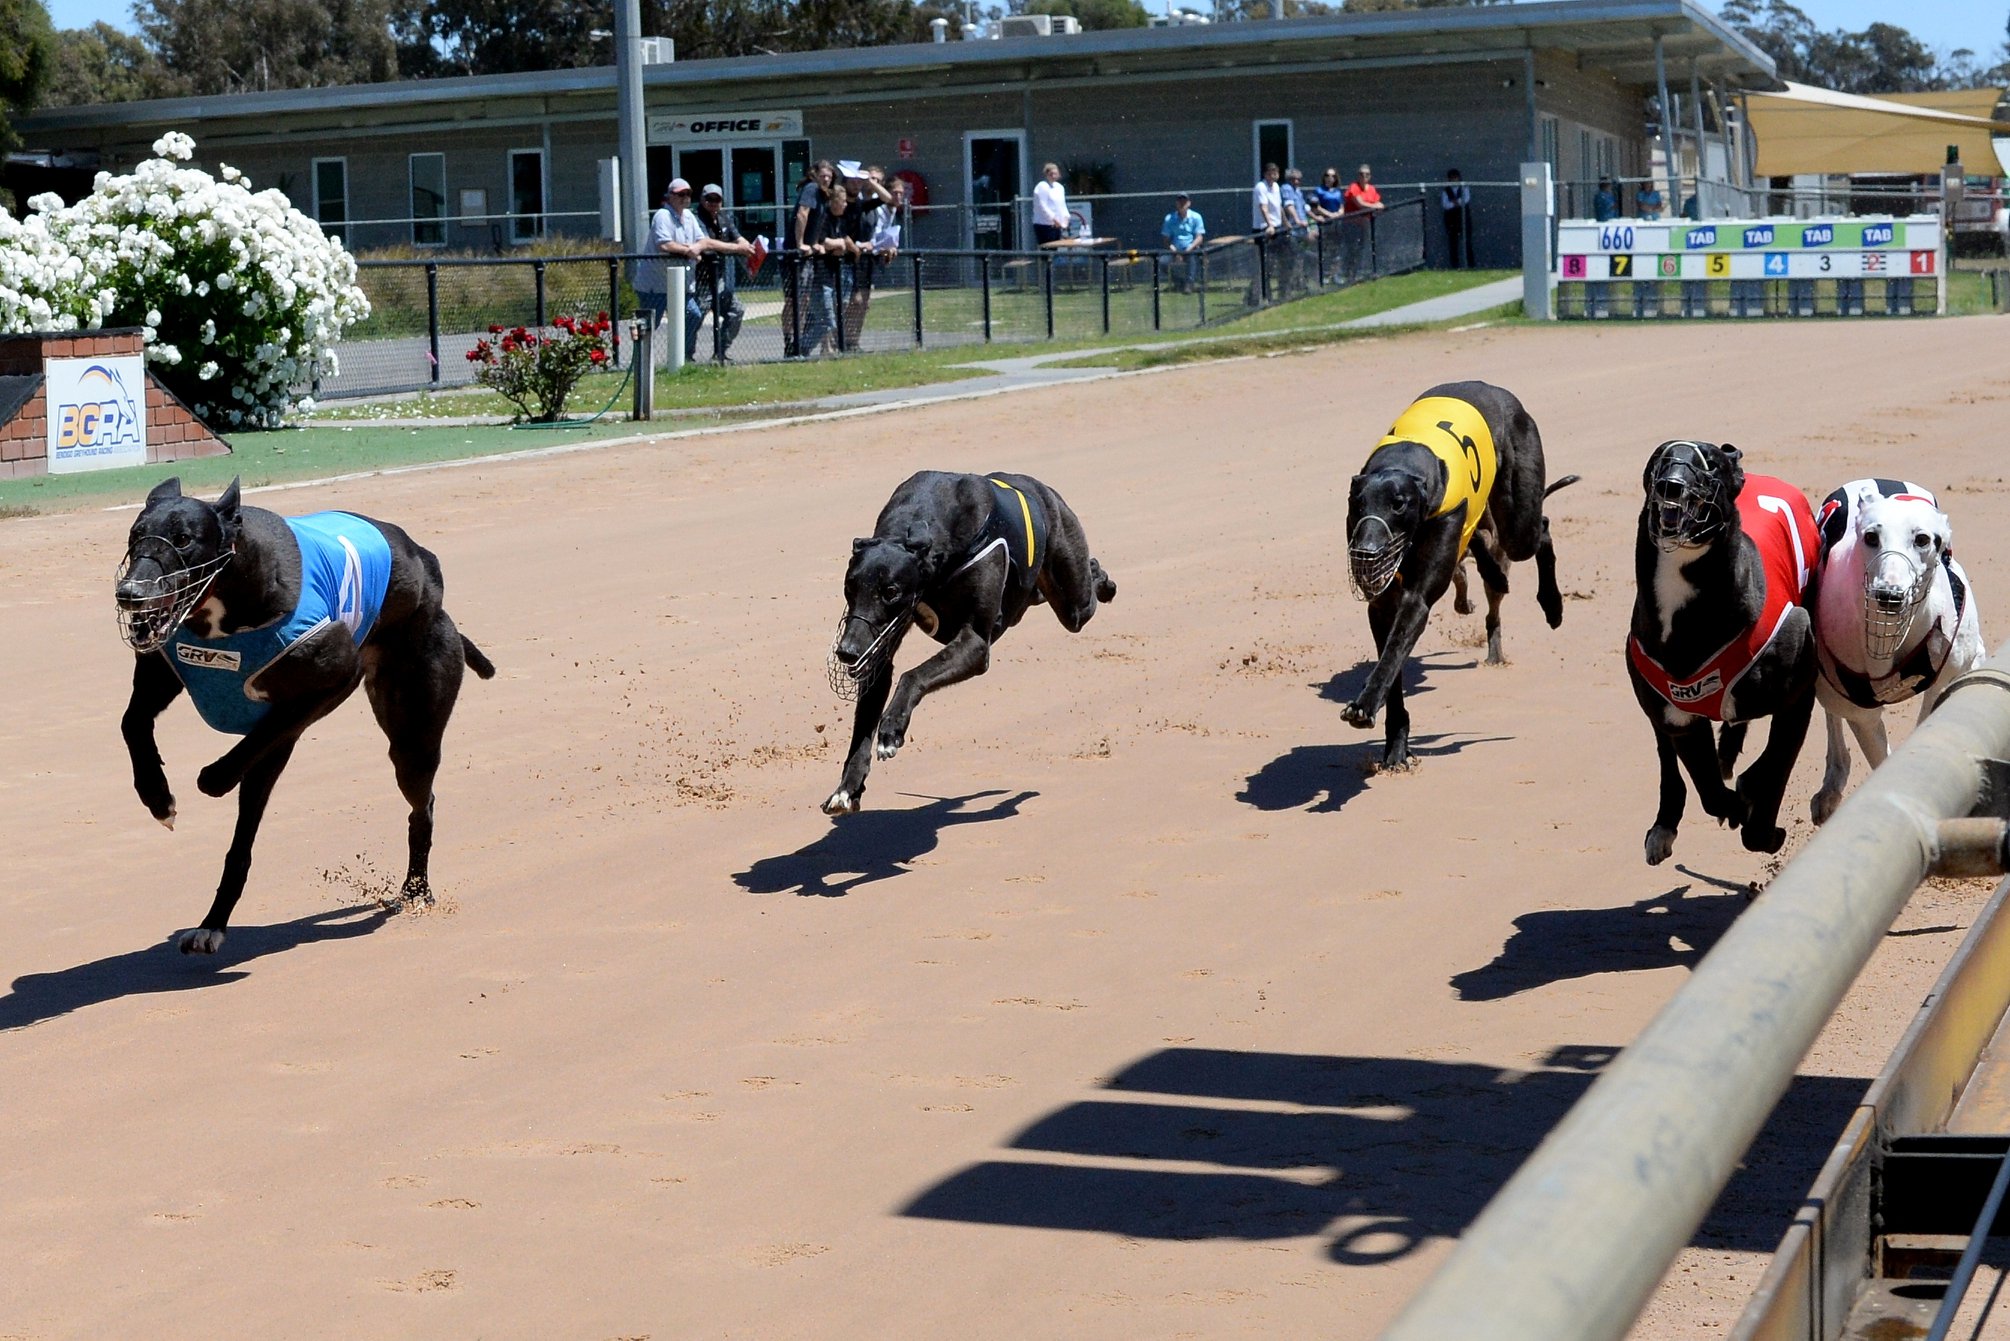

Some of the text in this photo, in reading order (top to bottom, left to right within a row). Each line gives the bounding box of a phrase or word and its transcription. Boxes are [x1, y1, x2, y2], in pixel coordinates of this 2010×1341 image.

[690, 119, 761, 133] OFFICE
[1602, 225, 1634, 250] 660
[1688, 231, 1715, 246] TAB
[1746, 230, 1773, 244] TAB
[1805, 228, 1832, 243] TAB
[1864, 227, 1892, 242] TAB
[1568, 253, 1928, 275] 8 7 6 5 4 3 2 1
[56, 400, 140, 450] BGRA
[1436, 420, 1482, 493] 5
[178, 645, 218, 663] GRV
[1670, 681, 1703, 699] GRV
